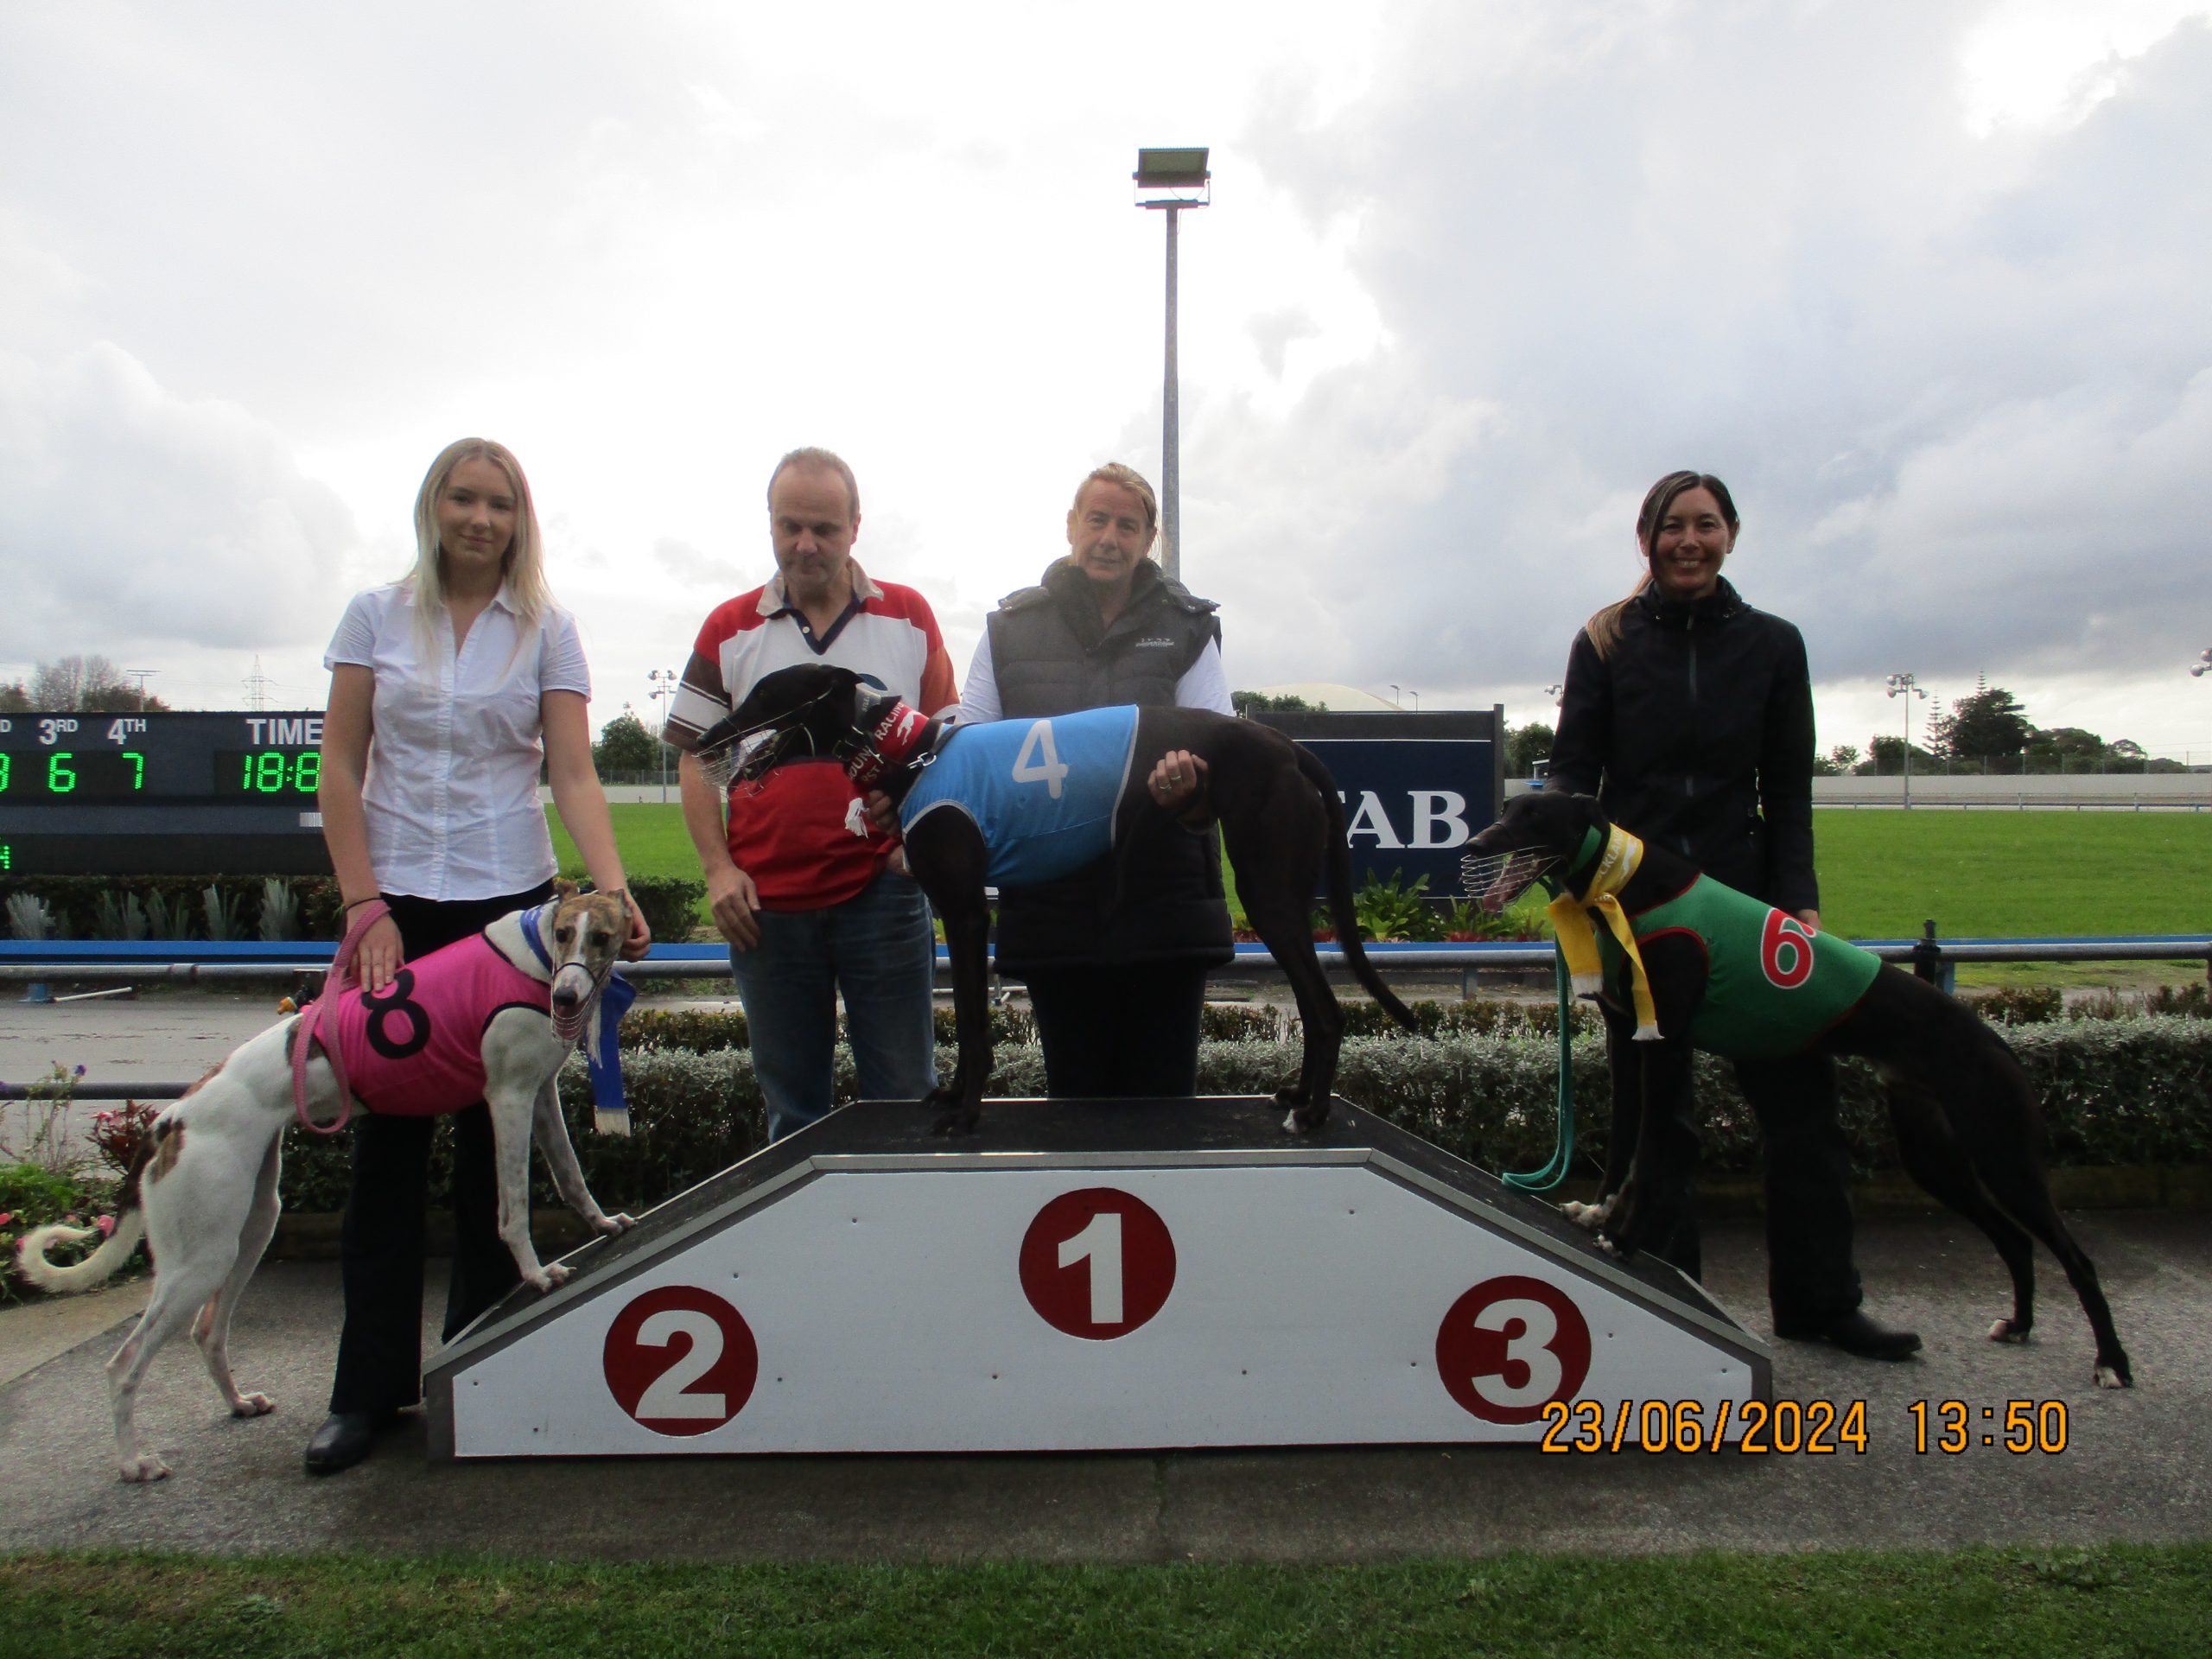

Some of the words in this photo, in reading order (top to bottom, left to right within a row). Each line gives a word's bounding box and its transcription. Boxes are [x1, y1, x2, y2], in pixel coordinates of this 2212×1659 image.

[39, 718, 79, 745] 3RD
[106, 718, 148, 745] 4TH
[245, 718, 324, 745] TIME
[48, 753, 76, 792] 6
[122, 753, 143, 790] 7
[1012, 719, 1069, 799] 4
[1337, 790, 1470, 849] AB
[1760, 907, 1817, 990] 6
[360, 968, 430, 1059] 8
[1058, 1212, 1124, 1325] 1
[634, 1309, 727, 1420] 2
[1471, 1298, 1563, 1408] 3
